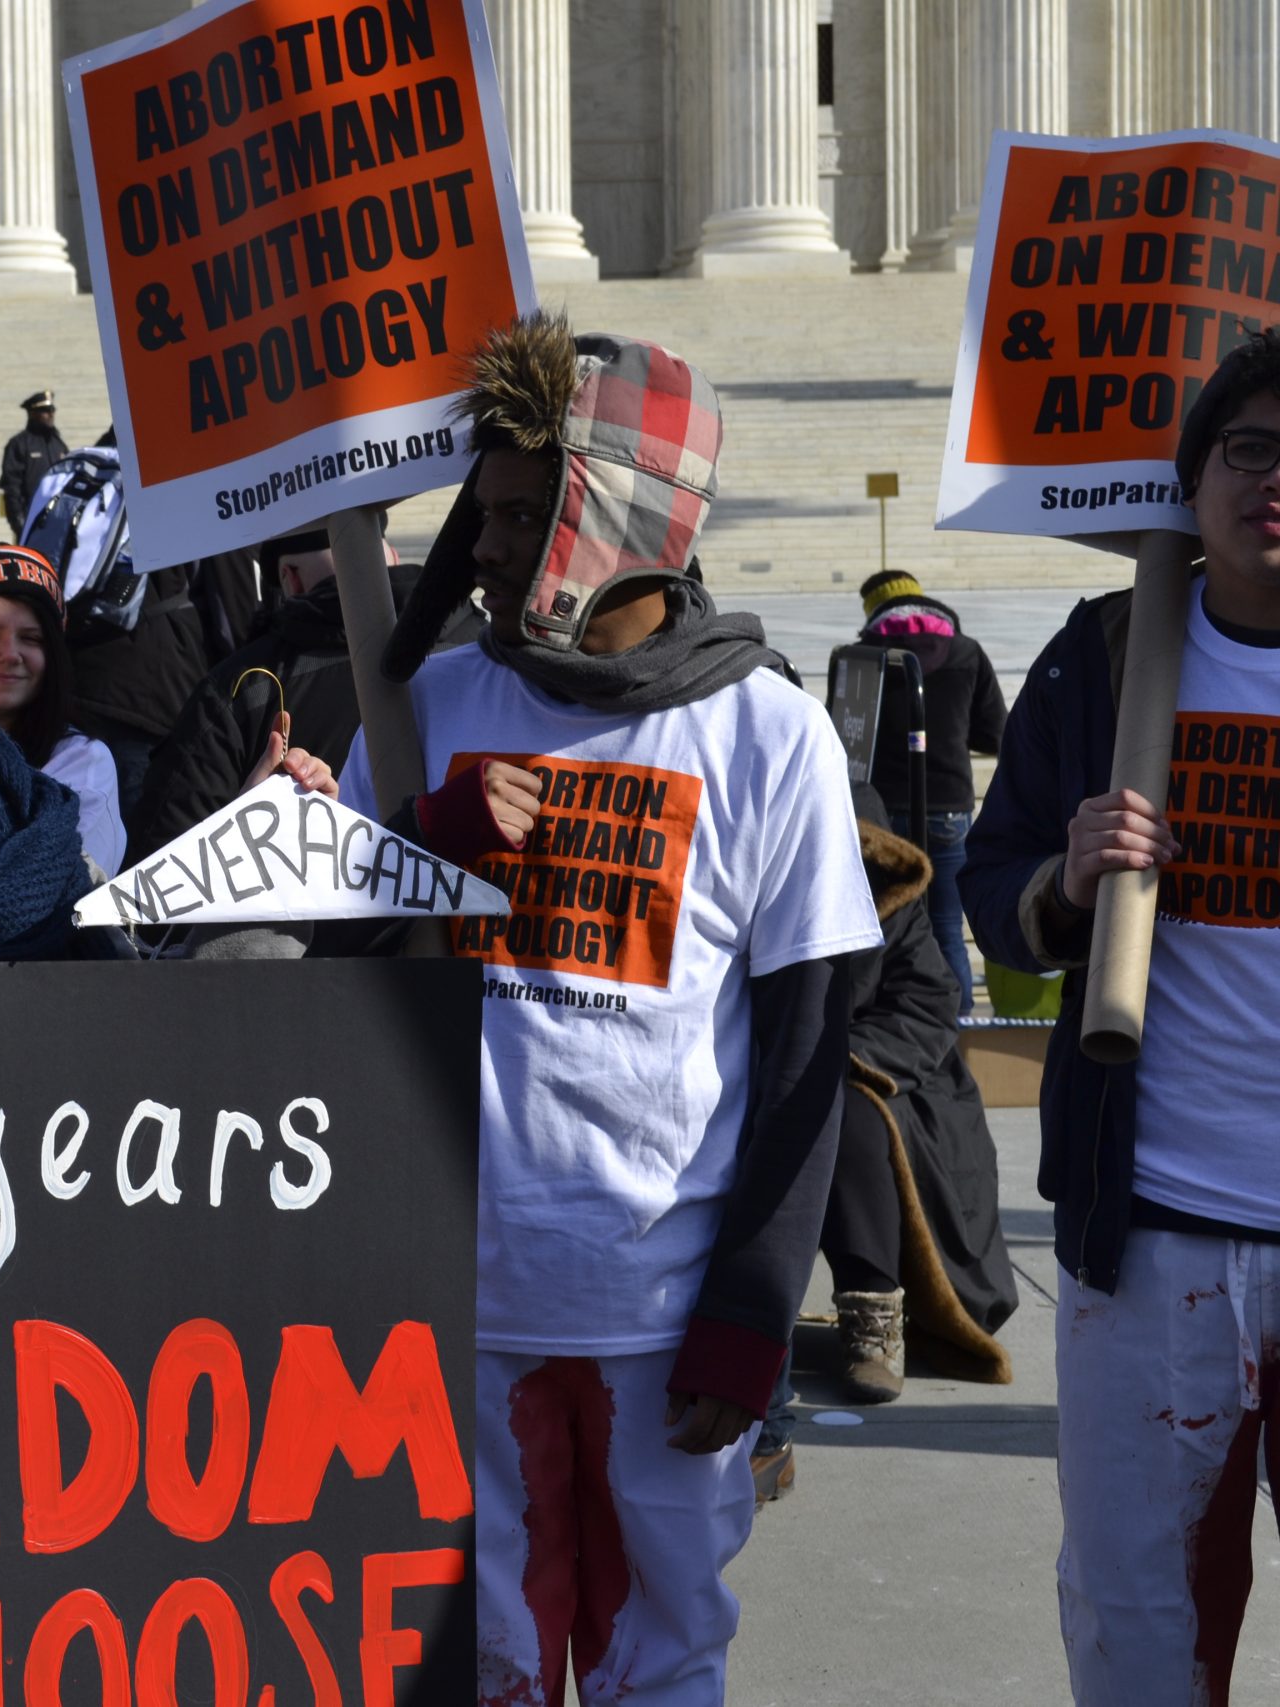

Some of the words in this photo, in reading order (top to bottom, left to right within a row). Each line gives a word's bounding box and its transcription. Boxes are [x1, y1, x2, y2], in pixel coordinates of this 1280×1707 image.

[134, 0, 435, 162] ABORTION
[119, 166, 201, 257] ON
[208, 76, 464, 226] DEMAND
[1048, 167, 1280, 236] ABORT
[135, 282, 187, 352] &
[192, 169, 475, 331] WITHOUT
[1010, 234, 1103, 288] ON
[189, 276, 449, 433] APOLOGY
[1001, 309, 1055, 362] &
[215, 427, 455, 520] StopPatriarchy.org
[522, 765, 668, 821] ORTION
[1166, 770, 1188, 813] N
[109, 800, 307, 924] NEVER
[298, 796, 466, 913] AGAIN
[458, 912, 627, 968] APOLOGY
